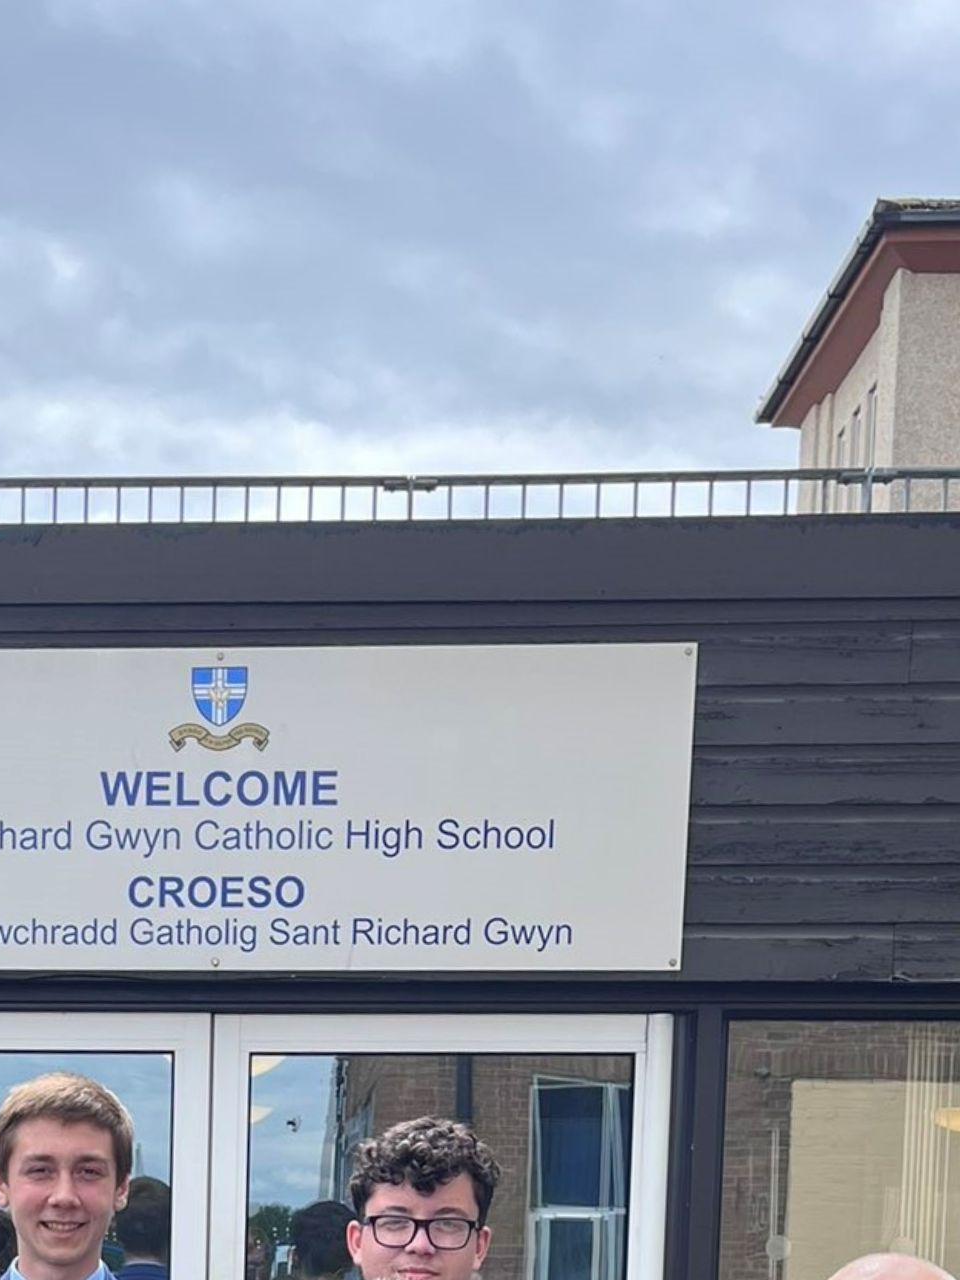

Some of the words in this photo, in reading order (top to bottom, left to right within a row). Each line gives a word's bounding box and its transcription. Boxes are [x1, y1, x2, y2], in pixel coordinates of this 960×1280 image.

[100, 769, 338, 807] WELCOME
[85, 819, 181, 859] Gwyn
[194, 819, 334, 851] Catholic
[346, 818, 423, 859] High
[436, 818, 555, 850] School
[128, 875, 305, 909] CROESO
[129, 917, 257, 953] Gatholig
[269, 917, 341, 946] Sant
[351, 917, 472, 946] Richard
[483, 916, 573, 953] Gwyn
